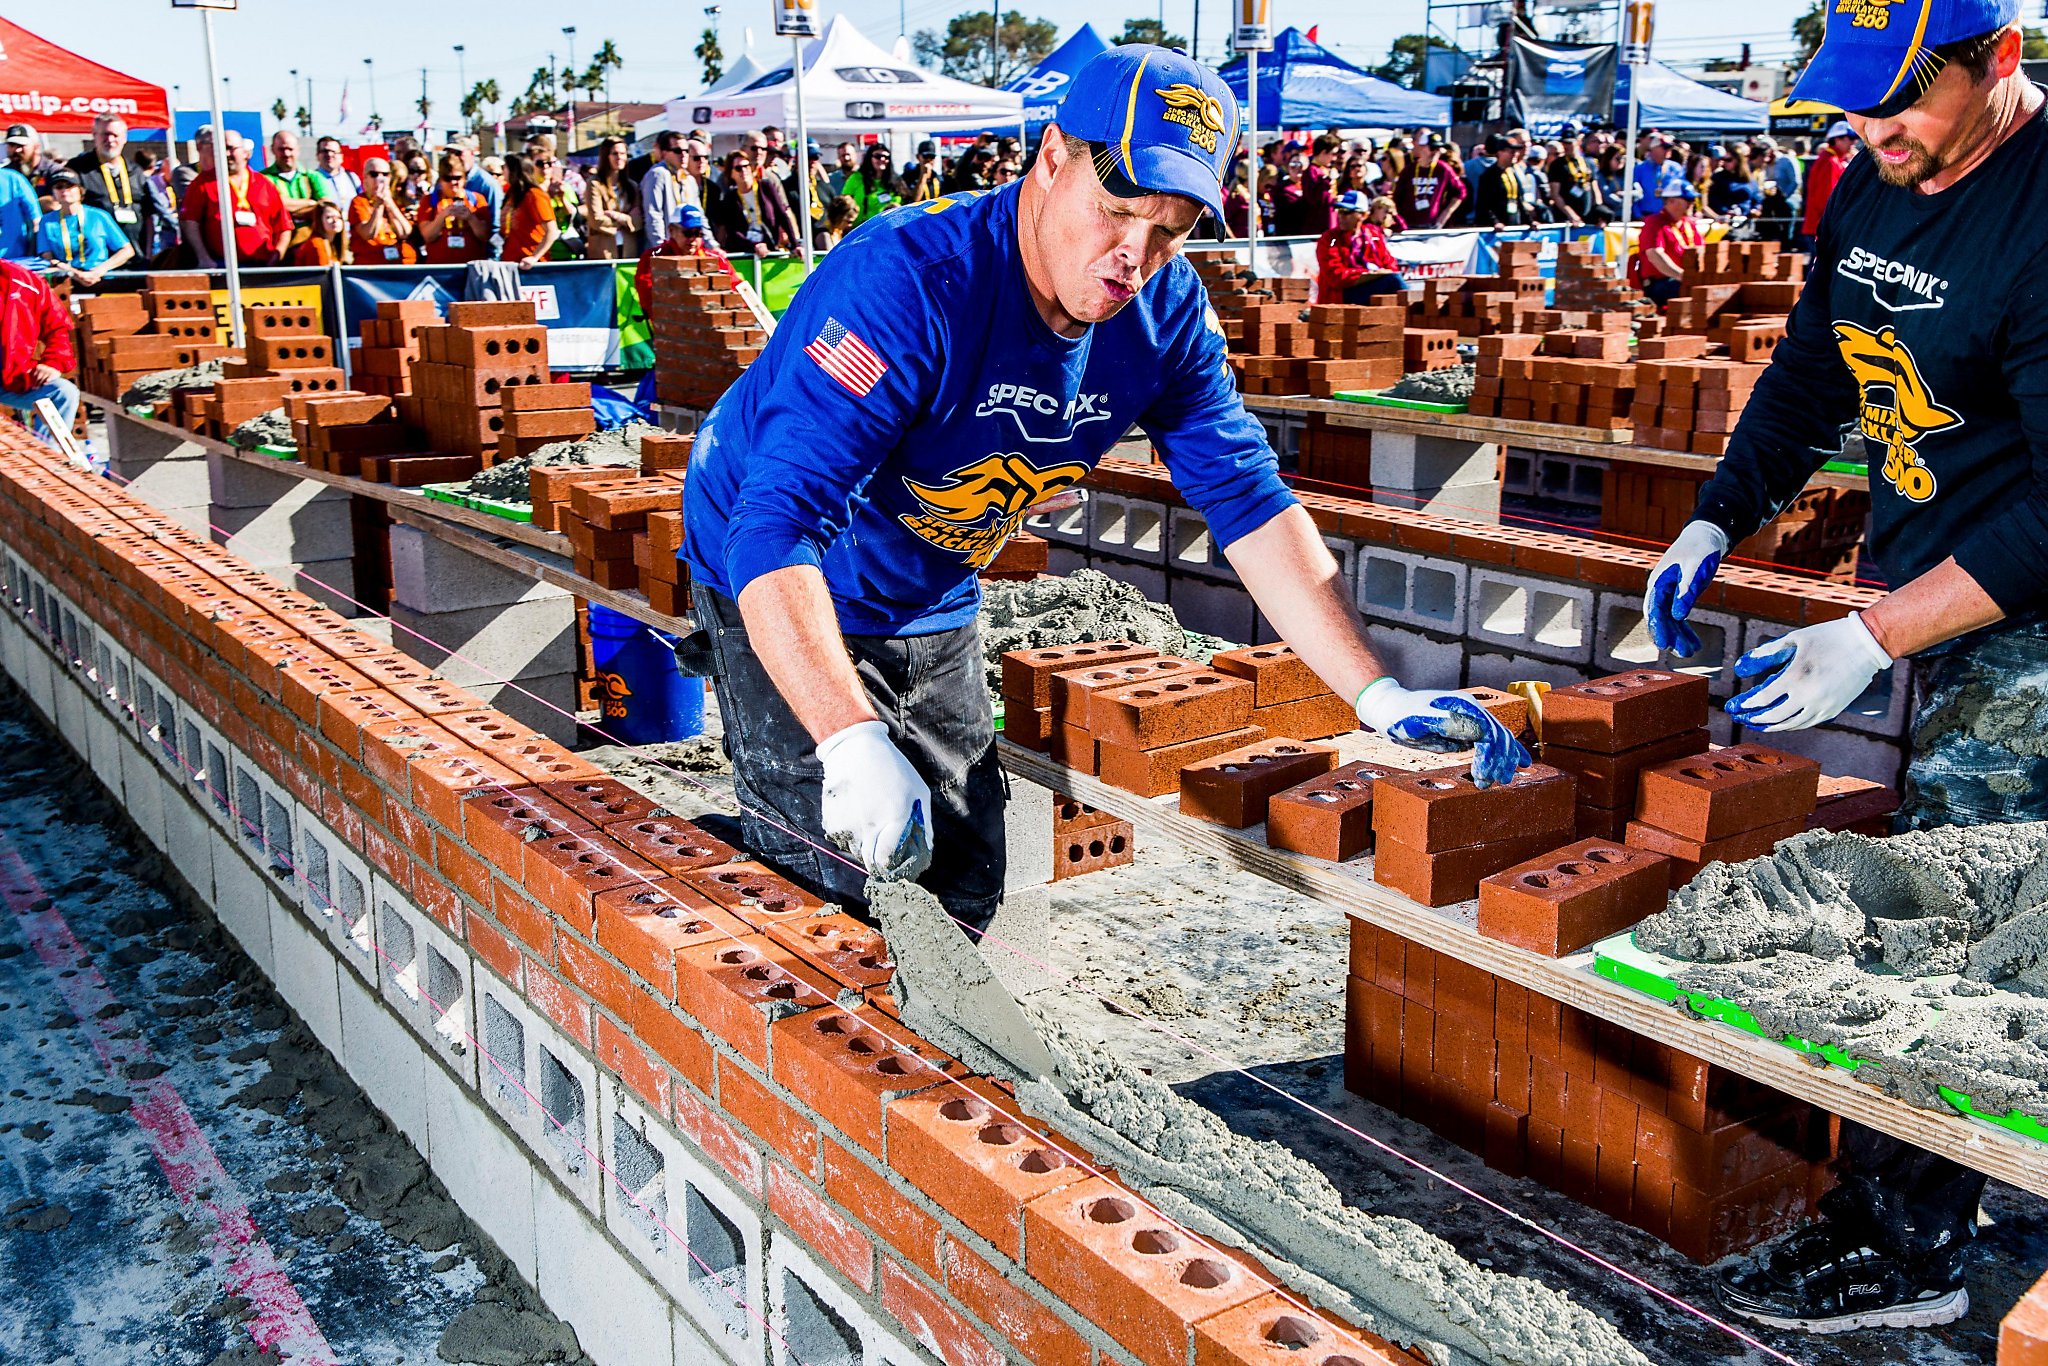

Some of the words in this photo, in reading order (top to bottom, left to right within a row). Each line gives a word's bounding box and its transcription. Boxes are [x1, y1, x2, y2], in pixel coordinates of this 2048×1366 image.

[1852, 13, 1888, 30] 500
[889, 104, 931, 115] POWER
[934, 104, 971, 115] TOOLS
[1189, 129, 1217, 154] 500
[920, 516, 968, 537] SPEC
[607, 706, 628, 718] 500
[1848, 1283, 1882, 1297] FILA
